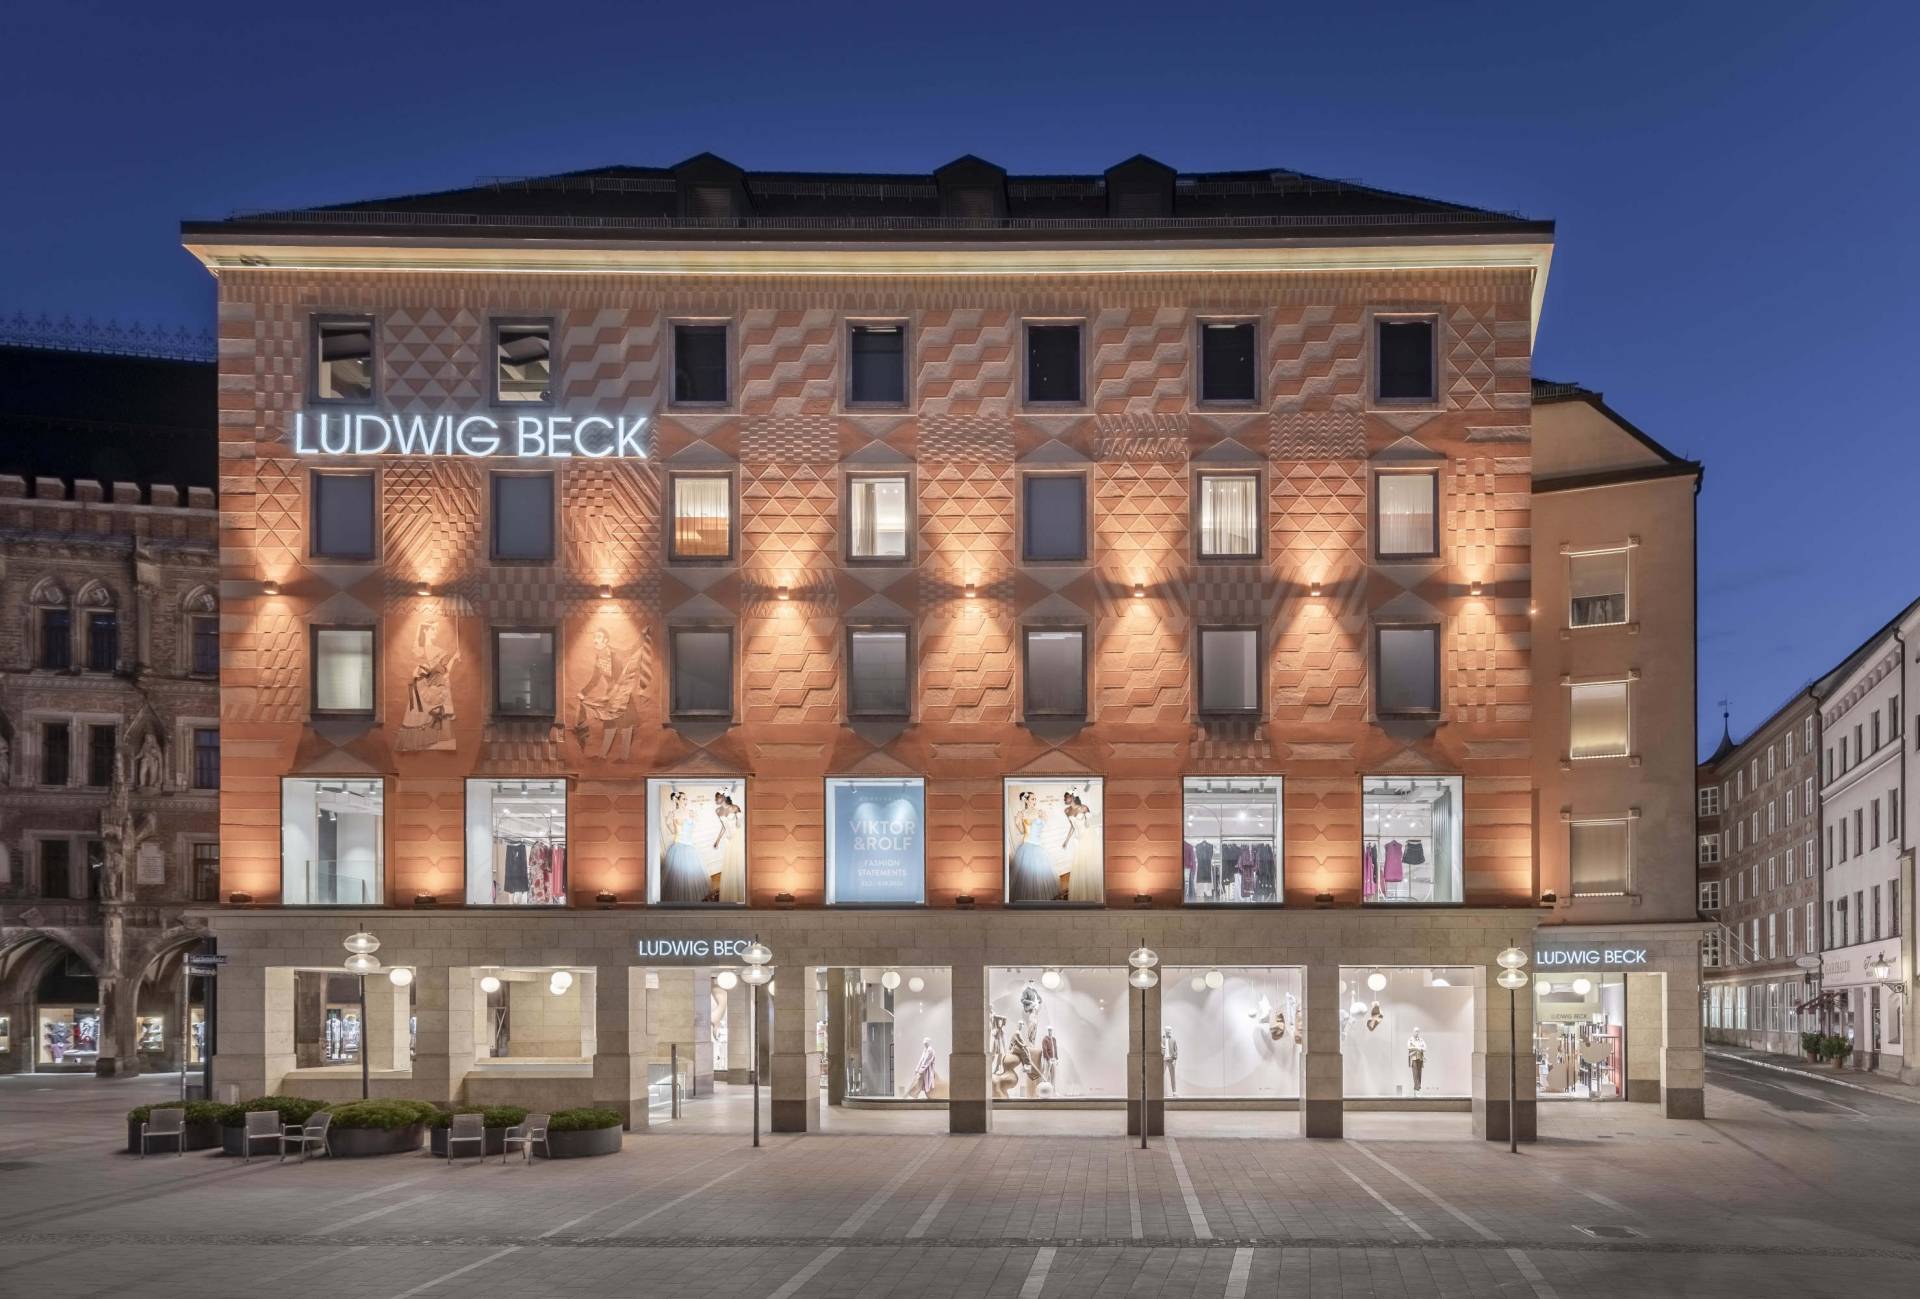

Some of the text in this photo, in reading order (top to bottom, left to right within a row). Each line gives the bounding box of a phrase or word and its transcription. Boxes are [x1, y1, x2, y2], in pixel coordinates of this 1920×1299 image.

[295, 413, 648, 459] LUDWIG BECK
[849, 820, 916, 835] VIKTOR
[853, 837, 912, 851] &ROLF
[639, 940, 709, 956] LUDWIG
[1536, 950, 1647, 965] LUDWIG BECK
